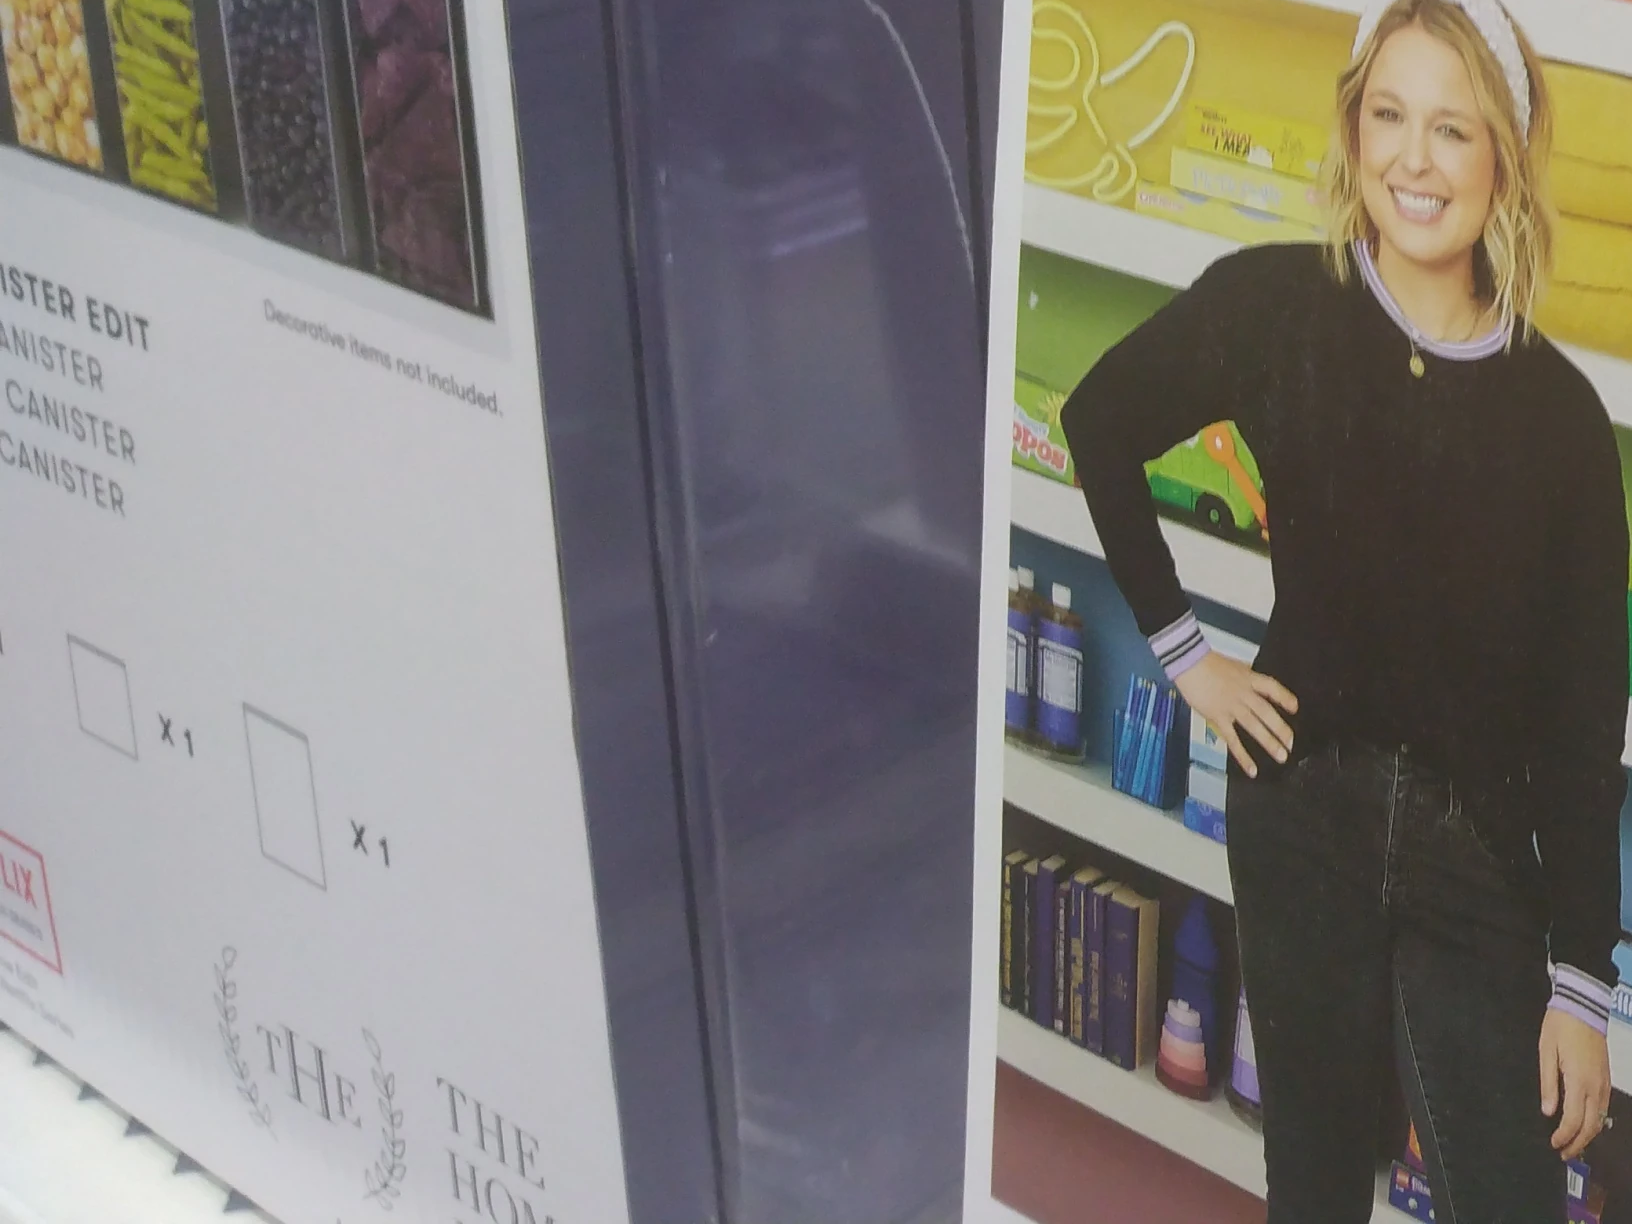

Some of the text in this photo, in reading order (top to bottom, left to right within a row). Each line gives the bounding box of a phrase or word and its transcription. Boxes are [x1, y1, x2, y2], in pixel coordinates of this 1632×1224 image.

[86, 294, 150, 353] EDIT
[263, 298, 504, 418] Decorative items not included.
[5, 378, 137, 466] CANISTER
[0, 429, 127, 520] CANISTER
[255, 1022, 363, 1130] THE
[435, 1075, 547, 1192] THE
